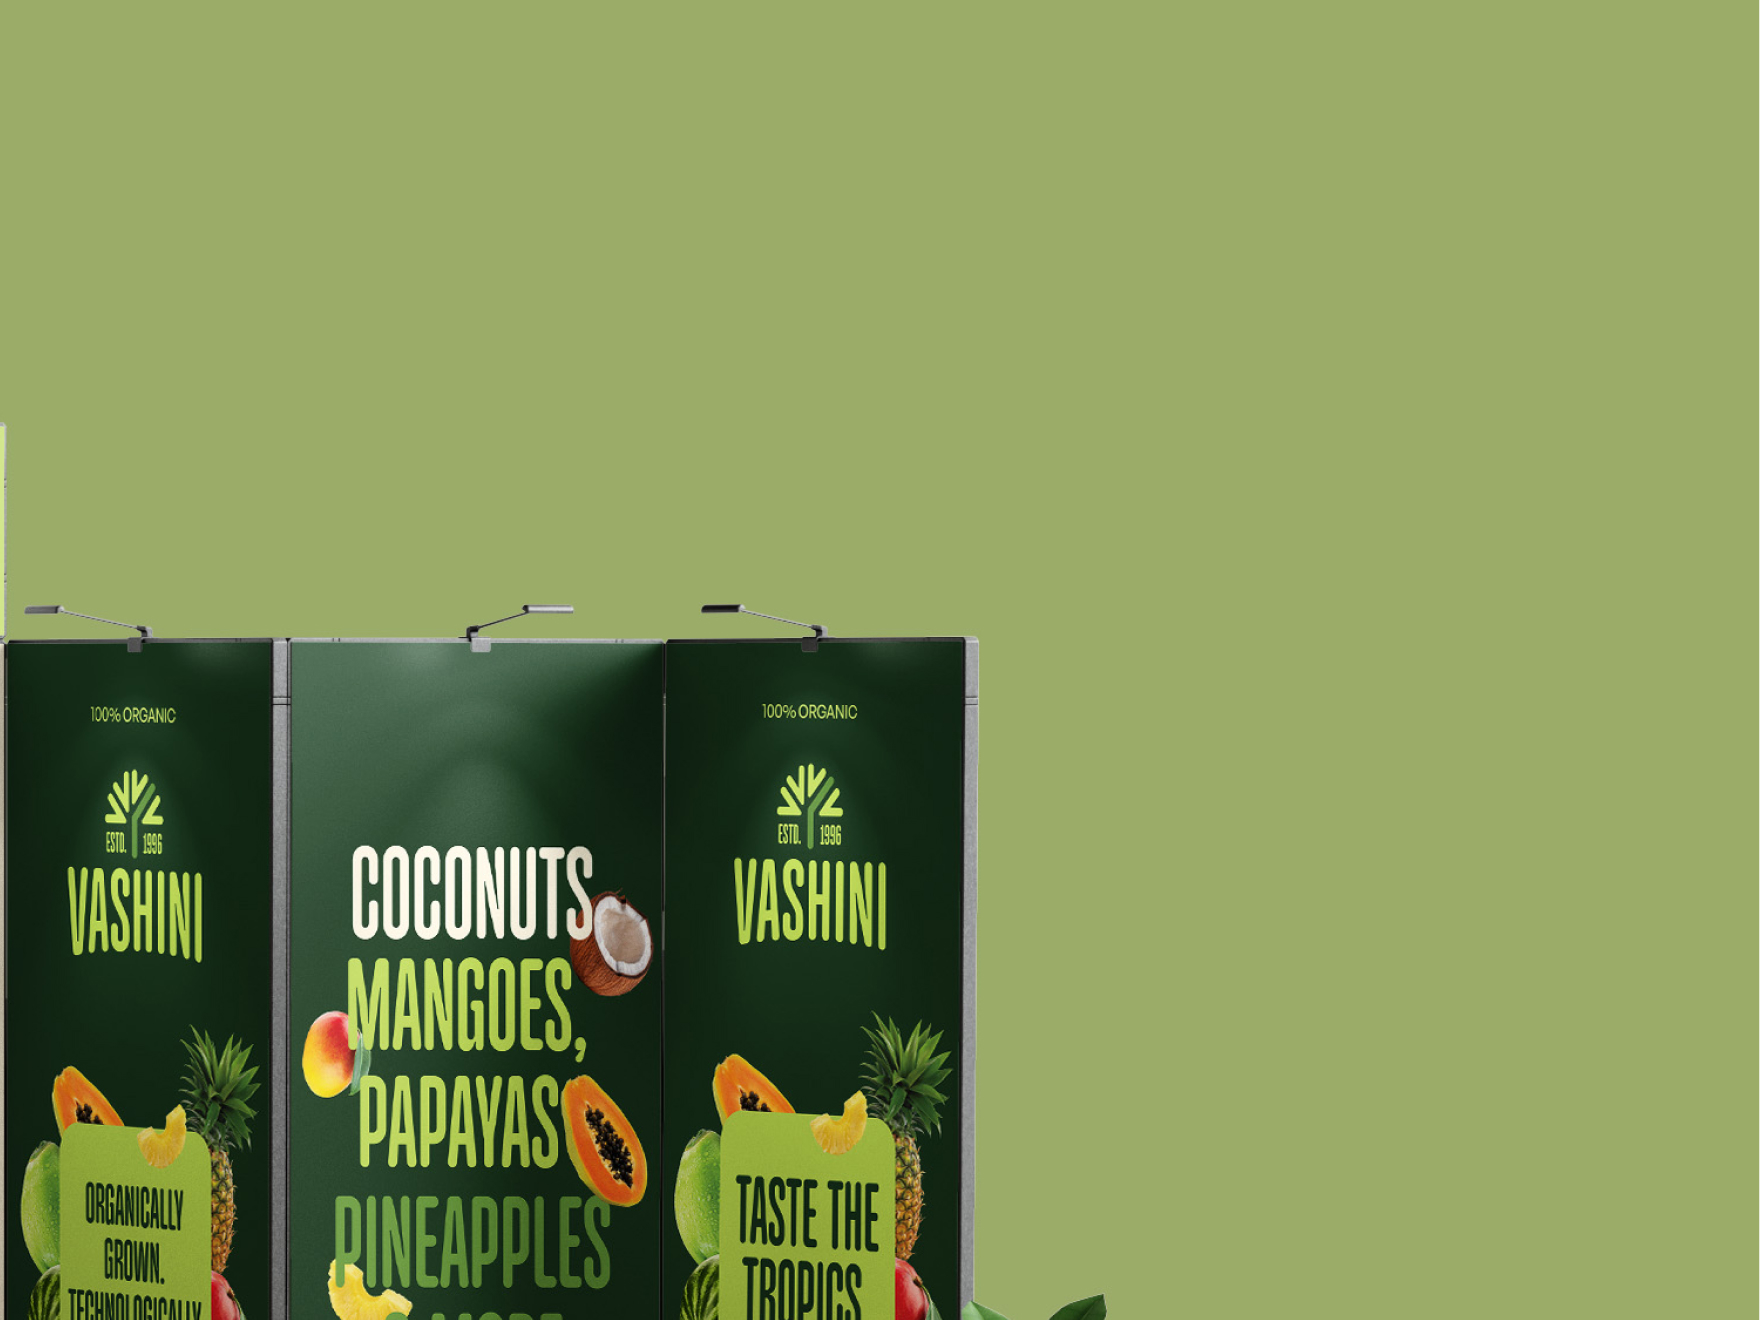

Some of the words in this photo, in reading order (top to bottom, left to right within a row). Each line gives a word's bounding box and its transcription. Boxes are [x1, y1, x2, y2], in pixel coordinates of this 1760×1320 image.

[90, 706, 121, 722] 100%
[123, 706, 176, 724] ORGANIC
[762, 703, 796, 719] 100%
[798, 704, 858, 720] ORGANIC
[106, 832, 127, 853] ESTD.
[143, 833, 163, 855] 1996
[778, 823, 801, 844] ESTD.
[820, 825, 842, 845] 1996
[67, 866, 203, 963] VASHINI
[352, 845, 593, 941] COCONUTS
[734, 857, 887, 951] VASHINI
[347, 957, 587, 1063] MANGOES,
[359, 1074, 559, 1169] PAPAYAS
[85, 1181, 184, 1231] ORGANICALLY
[335, 1195, 611, 1289] PINEAPPLES
[736, 1174, 818, 1248] TASTE
[827, 1180, 879, 1252] THE
[104, 1237, 165, 1285] GROWN.
